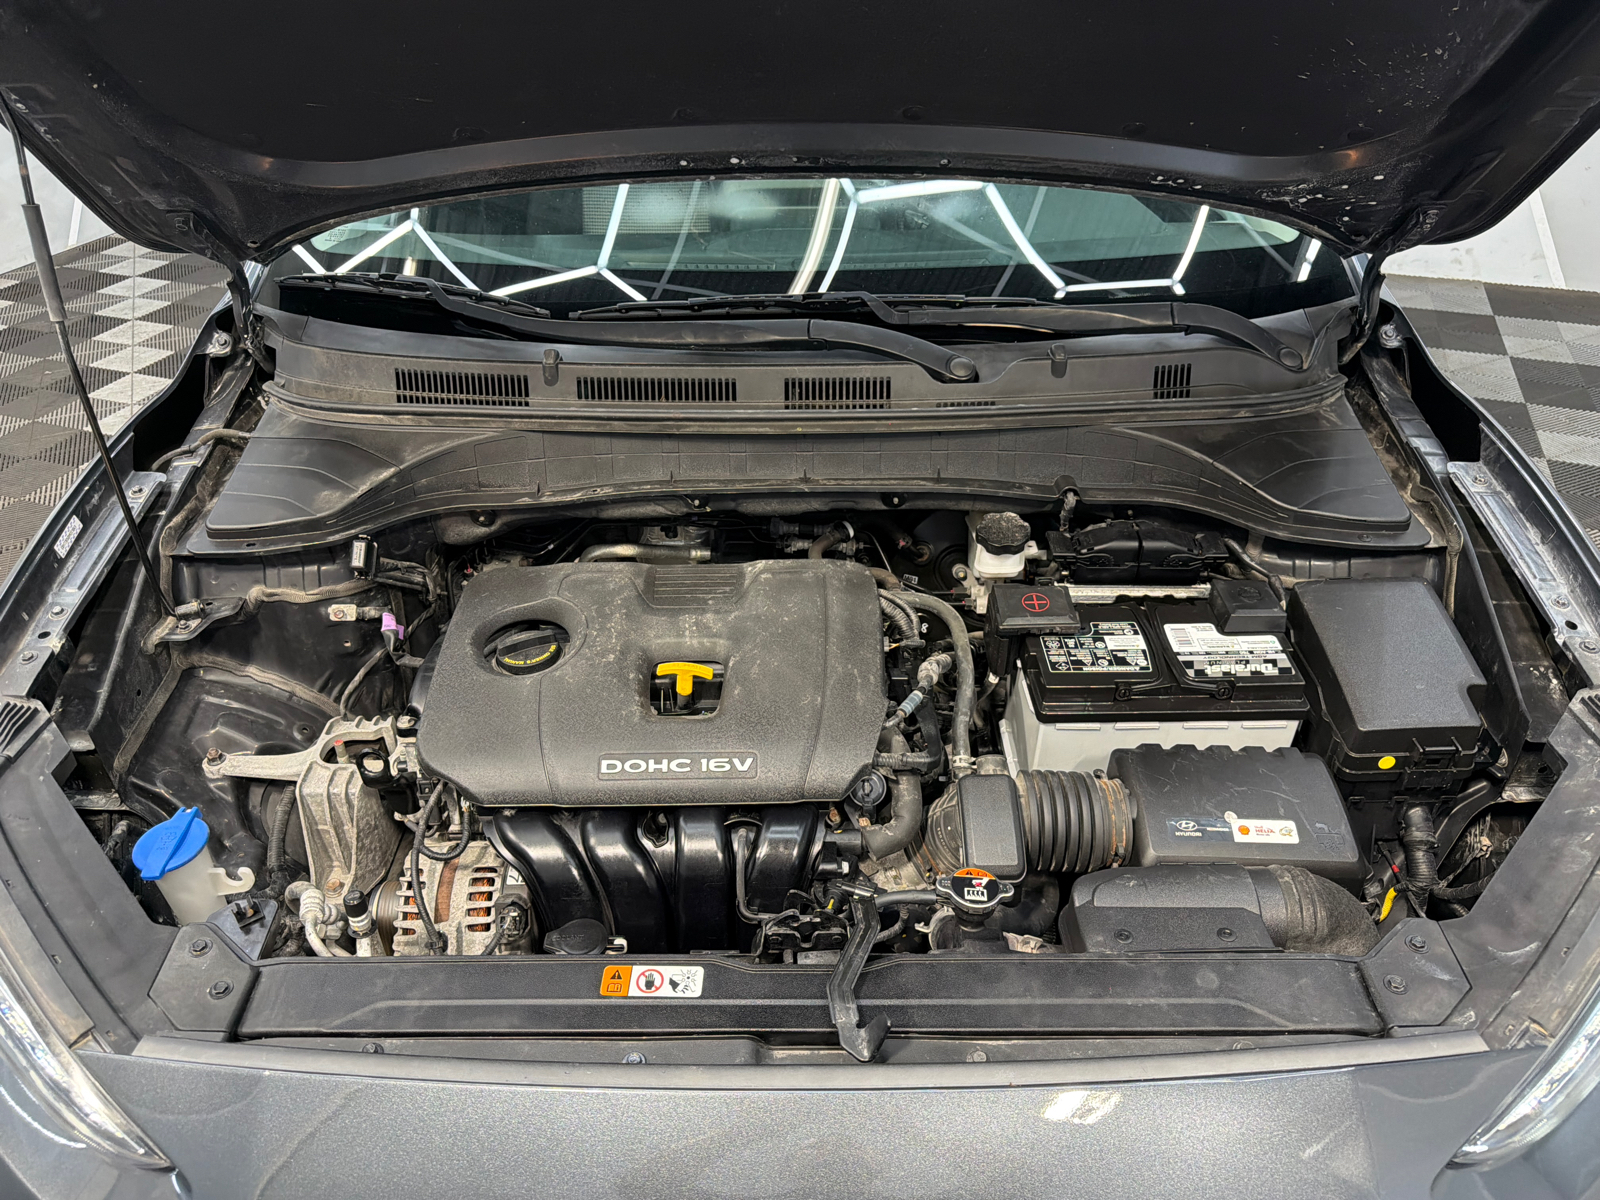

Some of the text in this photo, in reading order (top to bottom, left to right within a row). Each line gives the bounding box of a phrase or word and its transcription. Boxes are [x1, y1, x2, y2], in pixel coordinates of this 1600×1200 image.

[503, 657, 525, 665] MANUAL
[1203, 663, 1276, 675] Duralast
[601, 757, 754, 774] DOHC 16V
[551, 933, 585, 942] COOLANT
